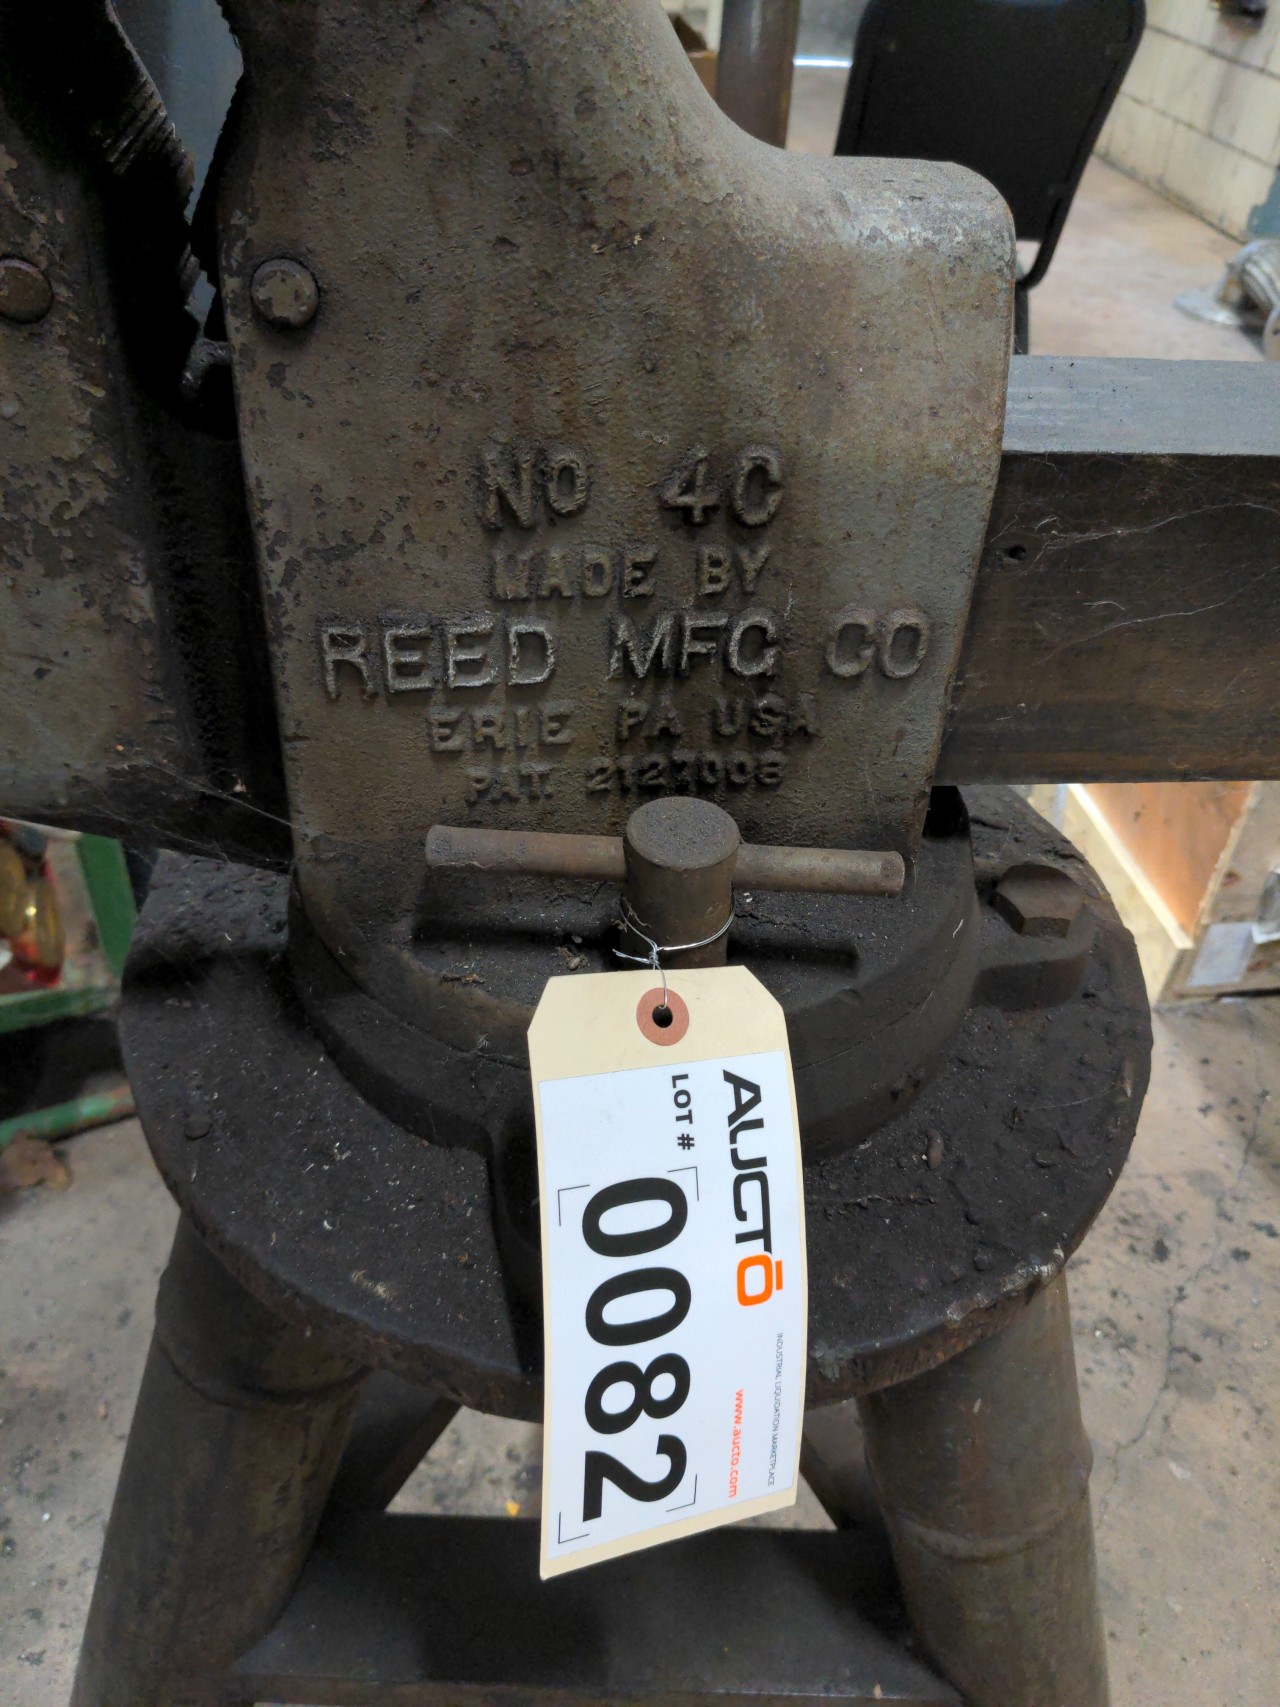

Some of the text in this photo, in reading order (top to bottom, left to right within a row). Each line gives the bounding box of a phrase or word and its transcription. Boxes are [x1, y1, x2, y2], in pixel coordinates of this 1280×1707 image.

[481, 443, 588, 529] NO
[490, 543, 773, 602] MADE BY
[317, 612, 557, 699] REED
[825, 605, 932, 680] CO
[427, 694, 820, 752] ERIE PA USA
[671, 1073, 695, 1151] LOT #
[582, 1177, 692, 1522] 0082
[728, 1389, 744, 1498] www.aucto.com
[767, 1332, 784, 1487] INDUSTRIAL LIQUIDATION MARKETPLACE
